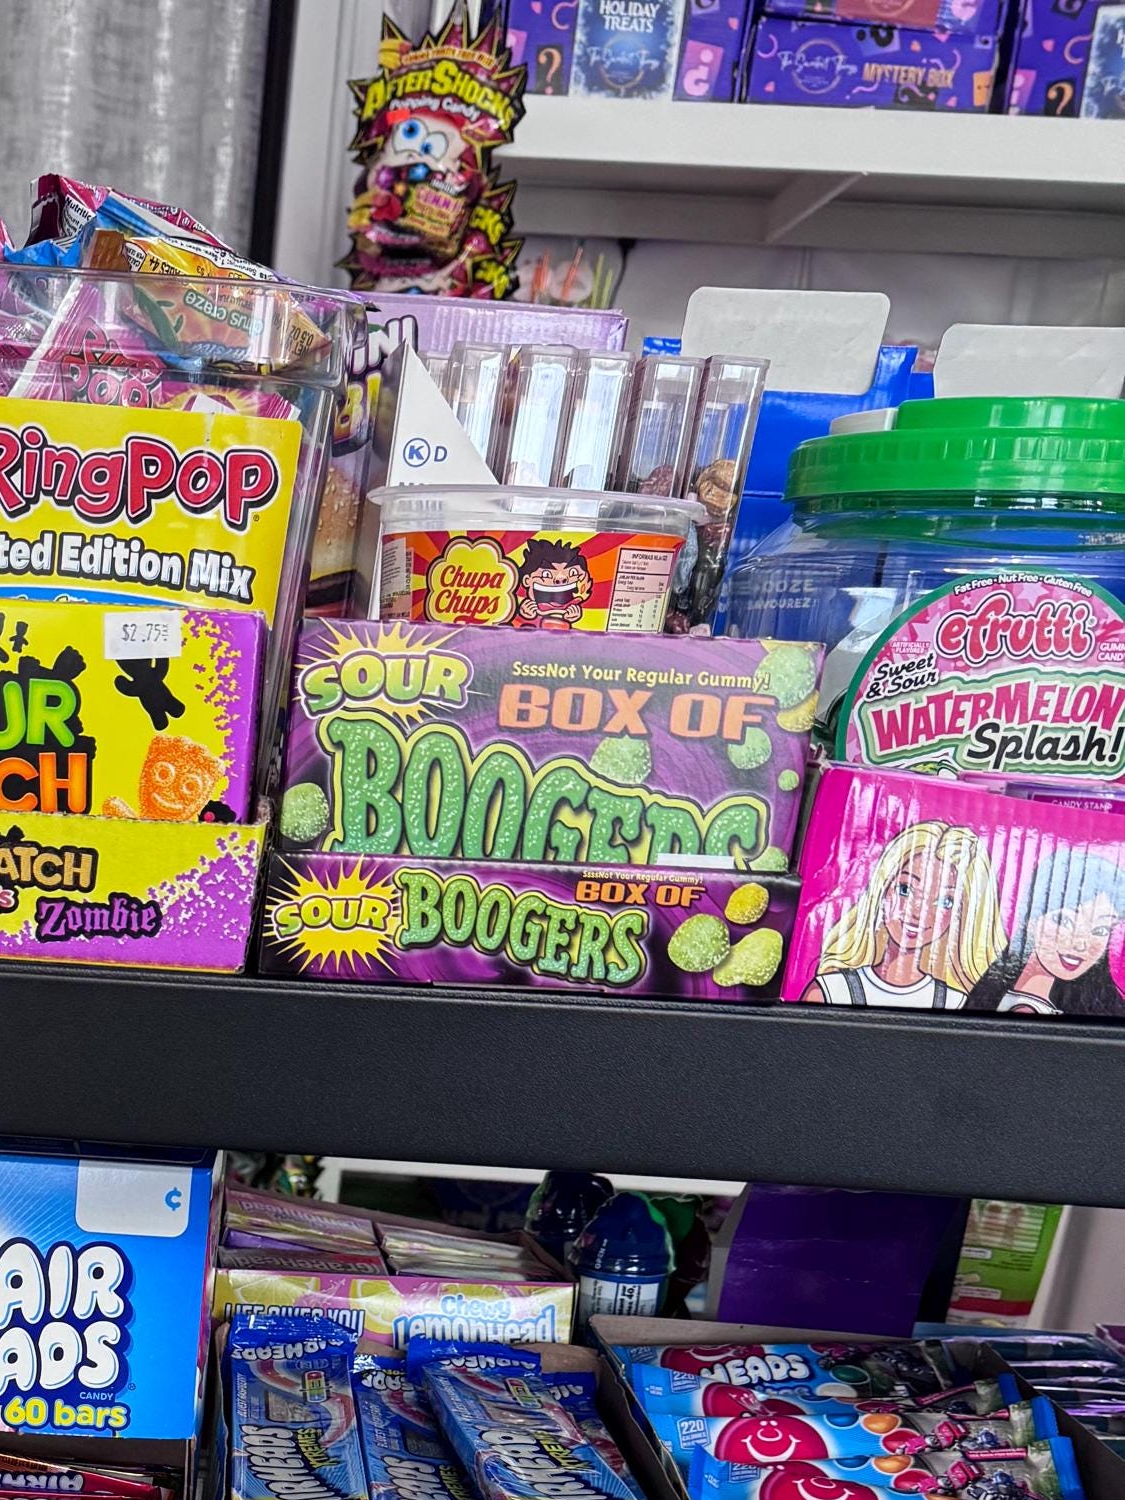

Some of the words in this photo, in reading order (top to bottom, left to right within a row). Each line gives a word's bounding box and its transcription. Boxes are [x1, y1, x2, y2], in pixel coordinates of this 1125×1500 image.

[599, 0, 660, 18] HOLIDAY
[603, 15, 655, 33] TREATS
[862, 62, 925, 86] MYSTERY
[926, 67, 956, 90] BOX
[60, 537, 181, 586] Edition
[191, 557, 253, 599] Mix
[437, 564, 505, 594] Chupa
[954, 584, 971, 595] Fat
[971, 578, 993, 589] Free
[999, 574, 1017, 583] Nut
[1018, 574, 1038, 583] Free
[1044, 575, 1073, 589] Gluten
[1072, 582, 1092, 597] Free
[433, 590, 501, 621] Chups
[513, 661, 577, 681] SsssNot
[582, 665, 621, 683] Your
[626, 667, 693, 690] Regular
[697, 670, 770, 694] Gummy!
[876, 653, 935, 681] Sweet
[302, 653, 468, 715] SOUR
[866, 682, 882, 699] &
[888, 669, 937, 695] Sour
[498, 684, 652, 735] BOX
[671, 694, 779, 741] OF
[871, 681, 1125, 753] WATERMELON
[966, 722, 1125, 770] Splash!
[39, 899, 159, 937] Zombie
[275, 900, 389, 936] SOUR
[400, 871, 647, 984] BOOGERS
[441, 1296, 511, 1320] Chewy
[4, 1399, 47, 1427] 60
[54, 1400, 128, 1428] bars
